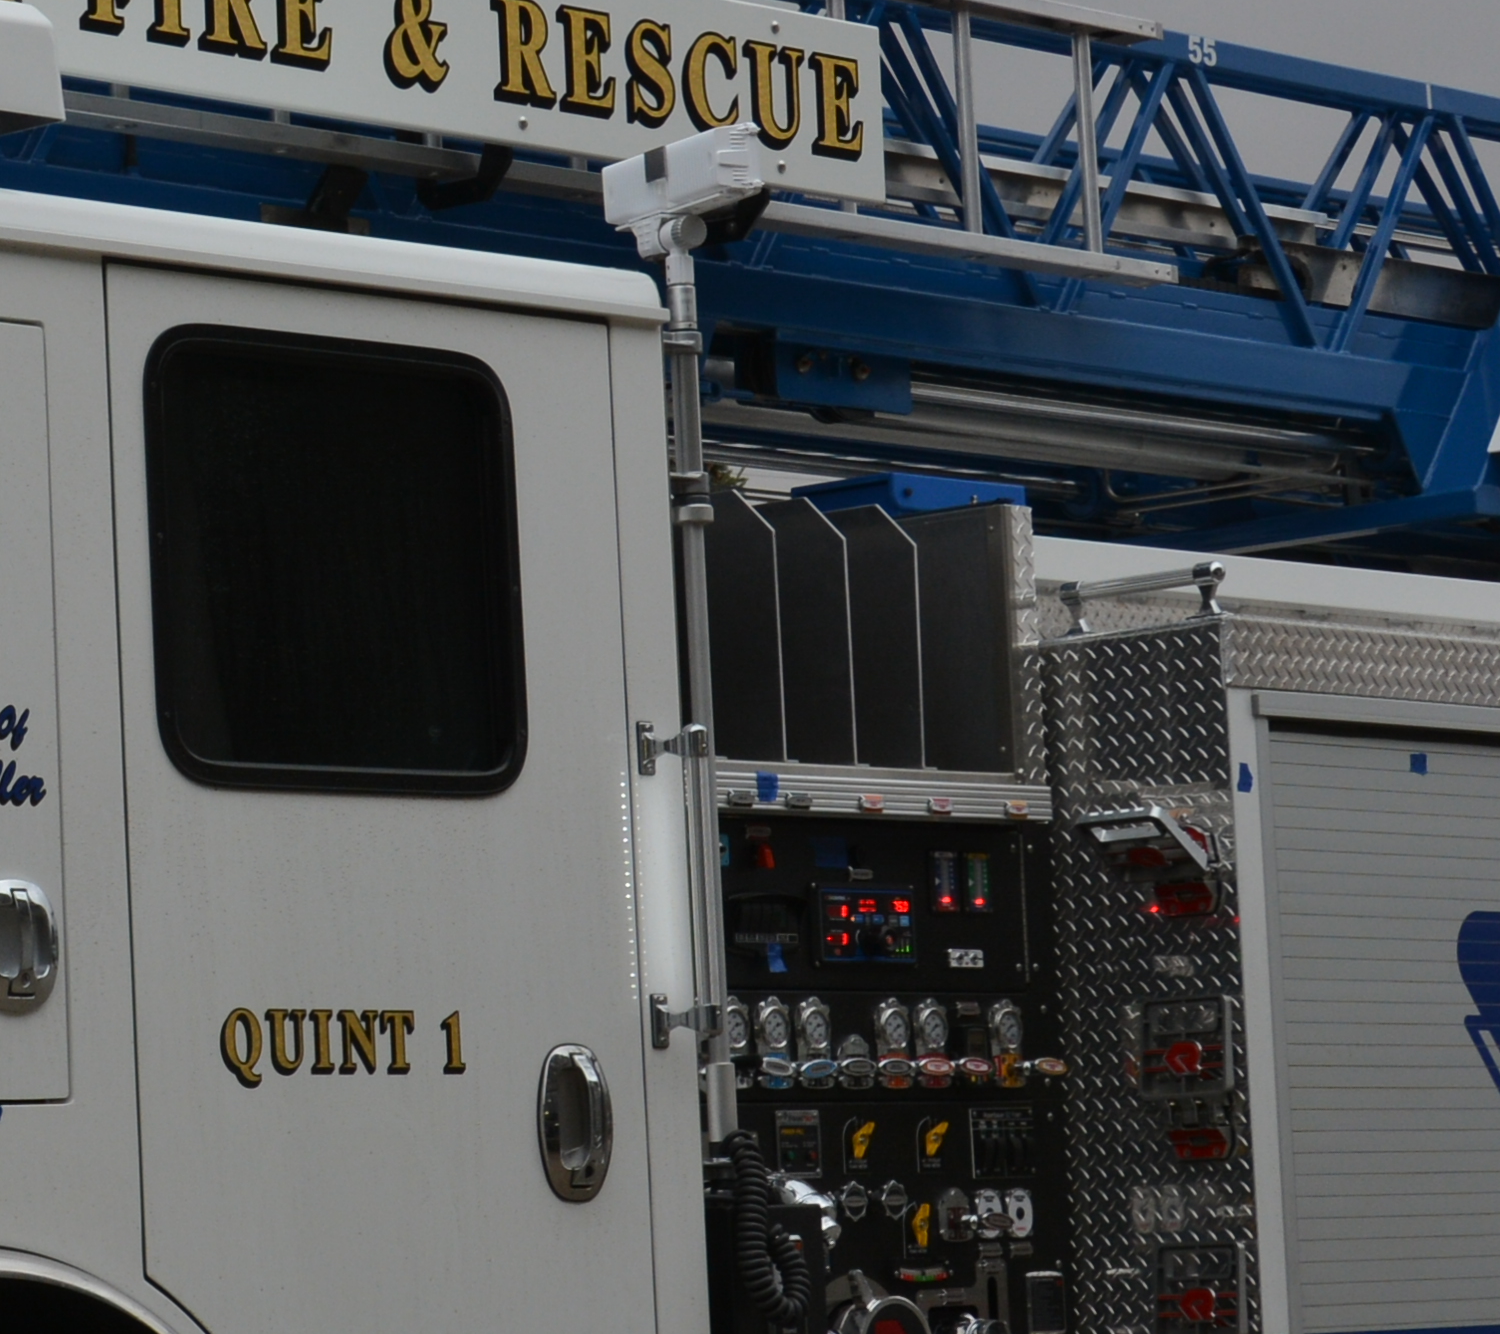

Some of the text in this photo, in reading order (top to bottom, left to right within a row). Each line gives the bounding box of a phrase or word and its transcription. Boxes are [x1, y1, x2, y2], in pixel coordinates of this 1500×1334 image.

[1188, 35, 1217, 67] 55
[220, 1007, 467, 1090] QUINT 1
